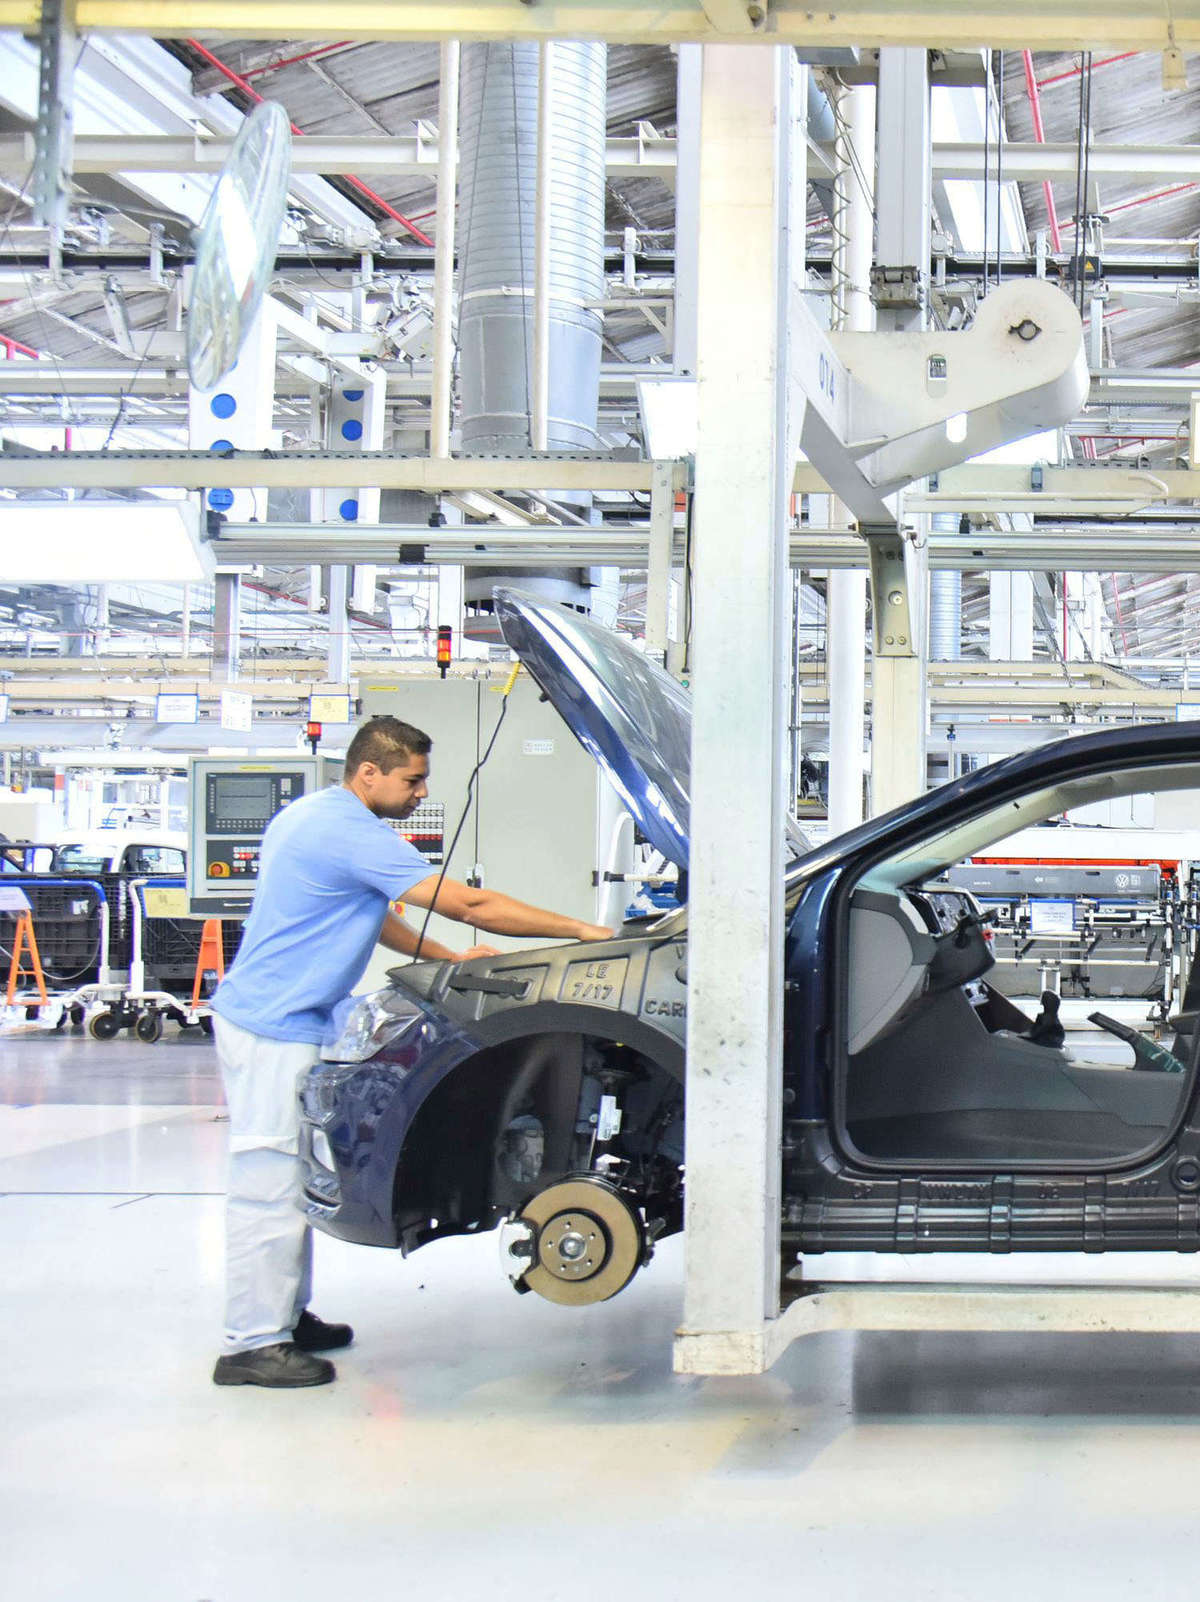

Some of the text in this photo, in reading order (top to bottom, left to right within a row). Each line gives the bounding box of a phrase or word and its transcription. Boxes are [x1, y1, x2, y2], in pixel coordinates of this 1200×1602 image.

[586, 964, 610, 979] LE
[572, 982, 613, 1001] 7/17
[645, 999, 687, 1017] CAR
